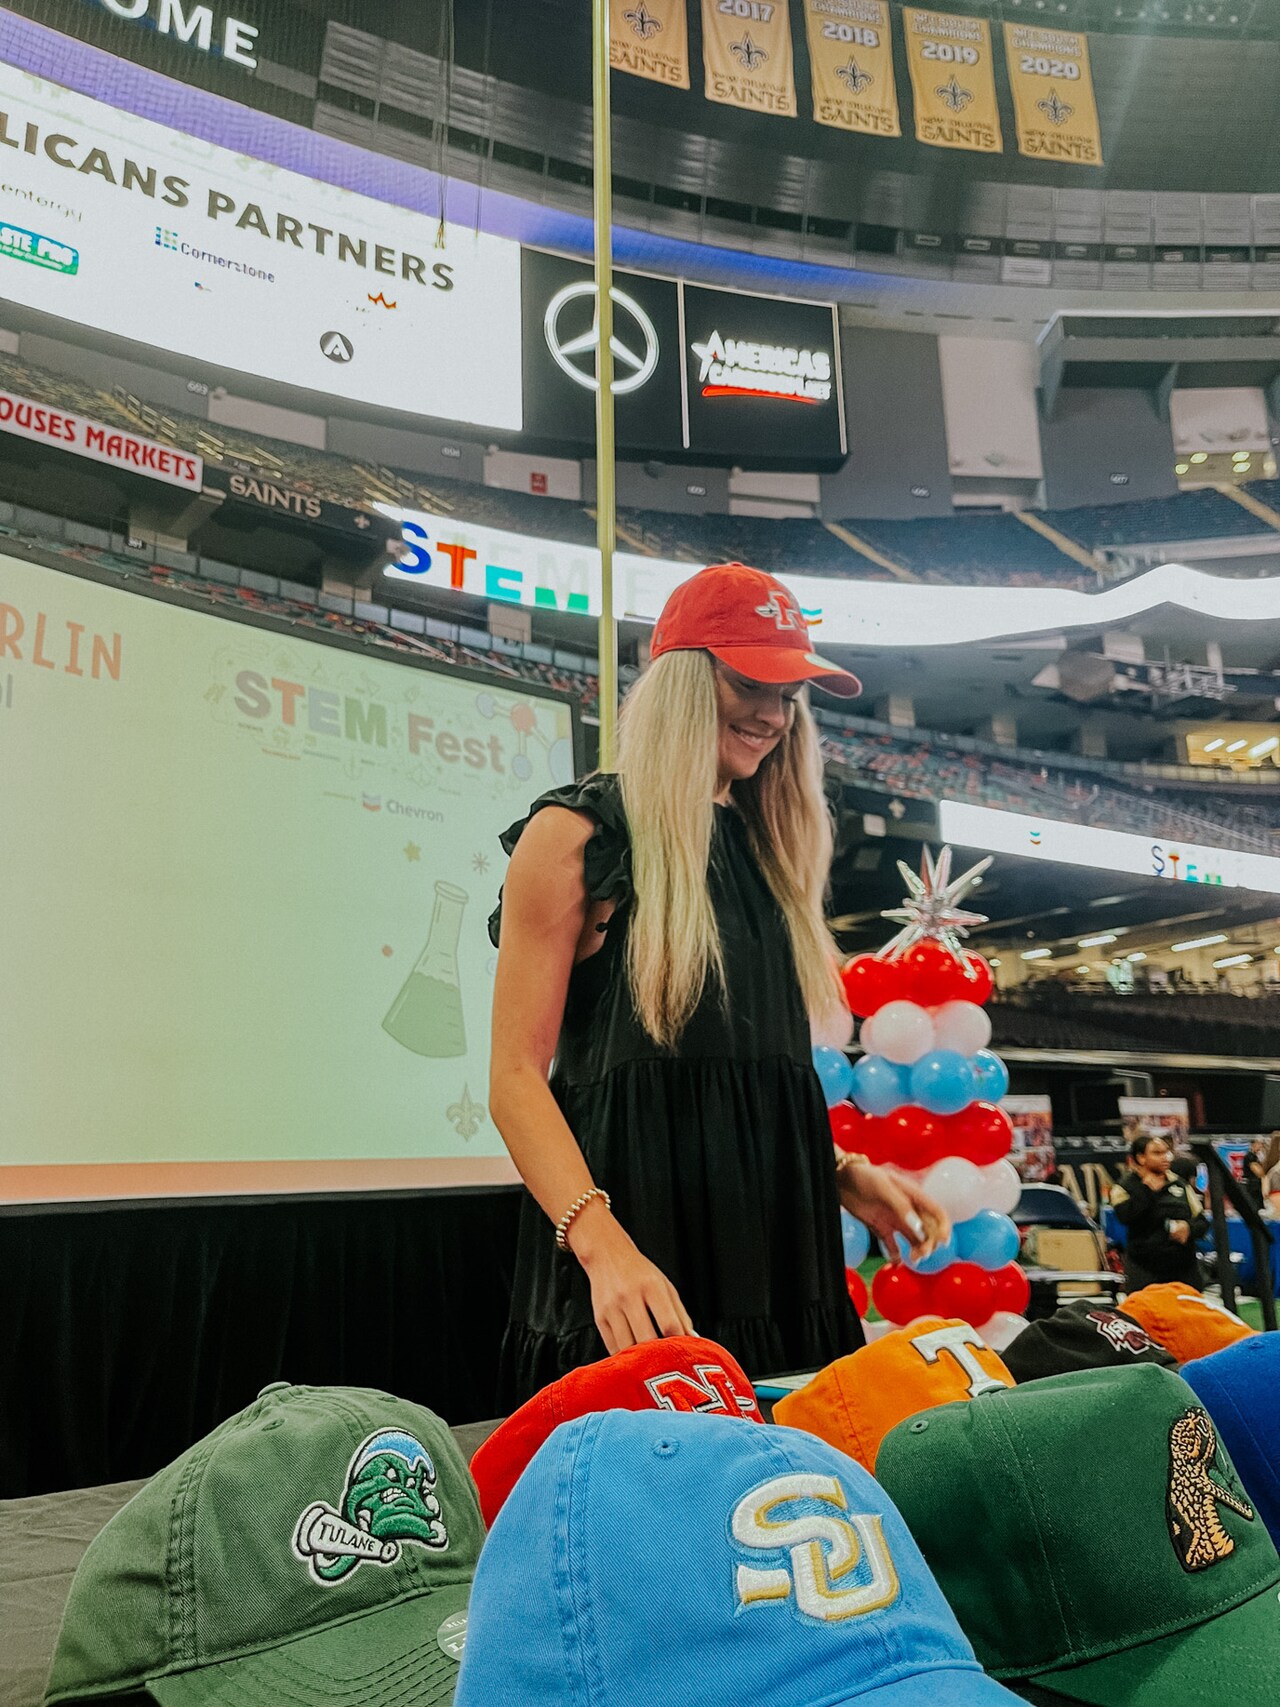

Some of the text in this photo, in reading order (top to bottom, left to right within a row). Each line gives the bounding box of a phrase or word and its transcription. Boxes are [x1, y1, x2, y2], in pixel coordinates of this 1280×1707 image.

[719, 0, 774, 23] 2017
[822, 20, 880, 48] 2018
[610, 47, 682, 82] SAINTS
[921, 40, 979, 66] 2019
[1019, 55, 1081, 81] 2020
[713, 81, 790, 111] SAINTS
[820, 105, 894, 133] SAINTS
[921, 125, 996, 148] SAINTS
[1023, 138, 1097, 160] SAINTS
[0, 111, 454, 292] LICANS PARTNERS
[181, 242, 275, 284] Cornerstone
[0, 397, 196, 481] OUSES MARKETS
[229, 474, 321, 518] SAINTS
[391, 521, 589, 614] STEM
[0, 602, 122, 681] RLIN
[234, 670, 506, 774] STEM Fest
[386, 799, 445, 824] Chevron
[1151, 845, 1222, 886] STEM
[909, 1325, 1008, 1397] T
[319, 1521, 375, 1551] TULANE
